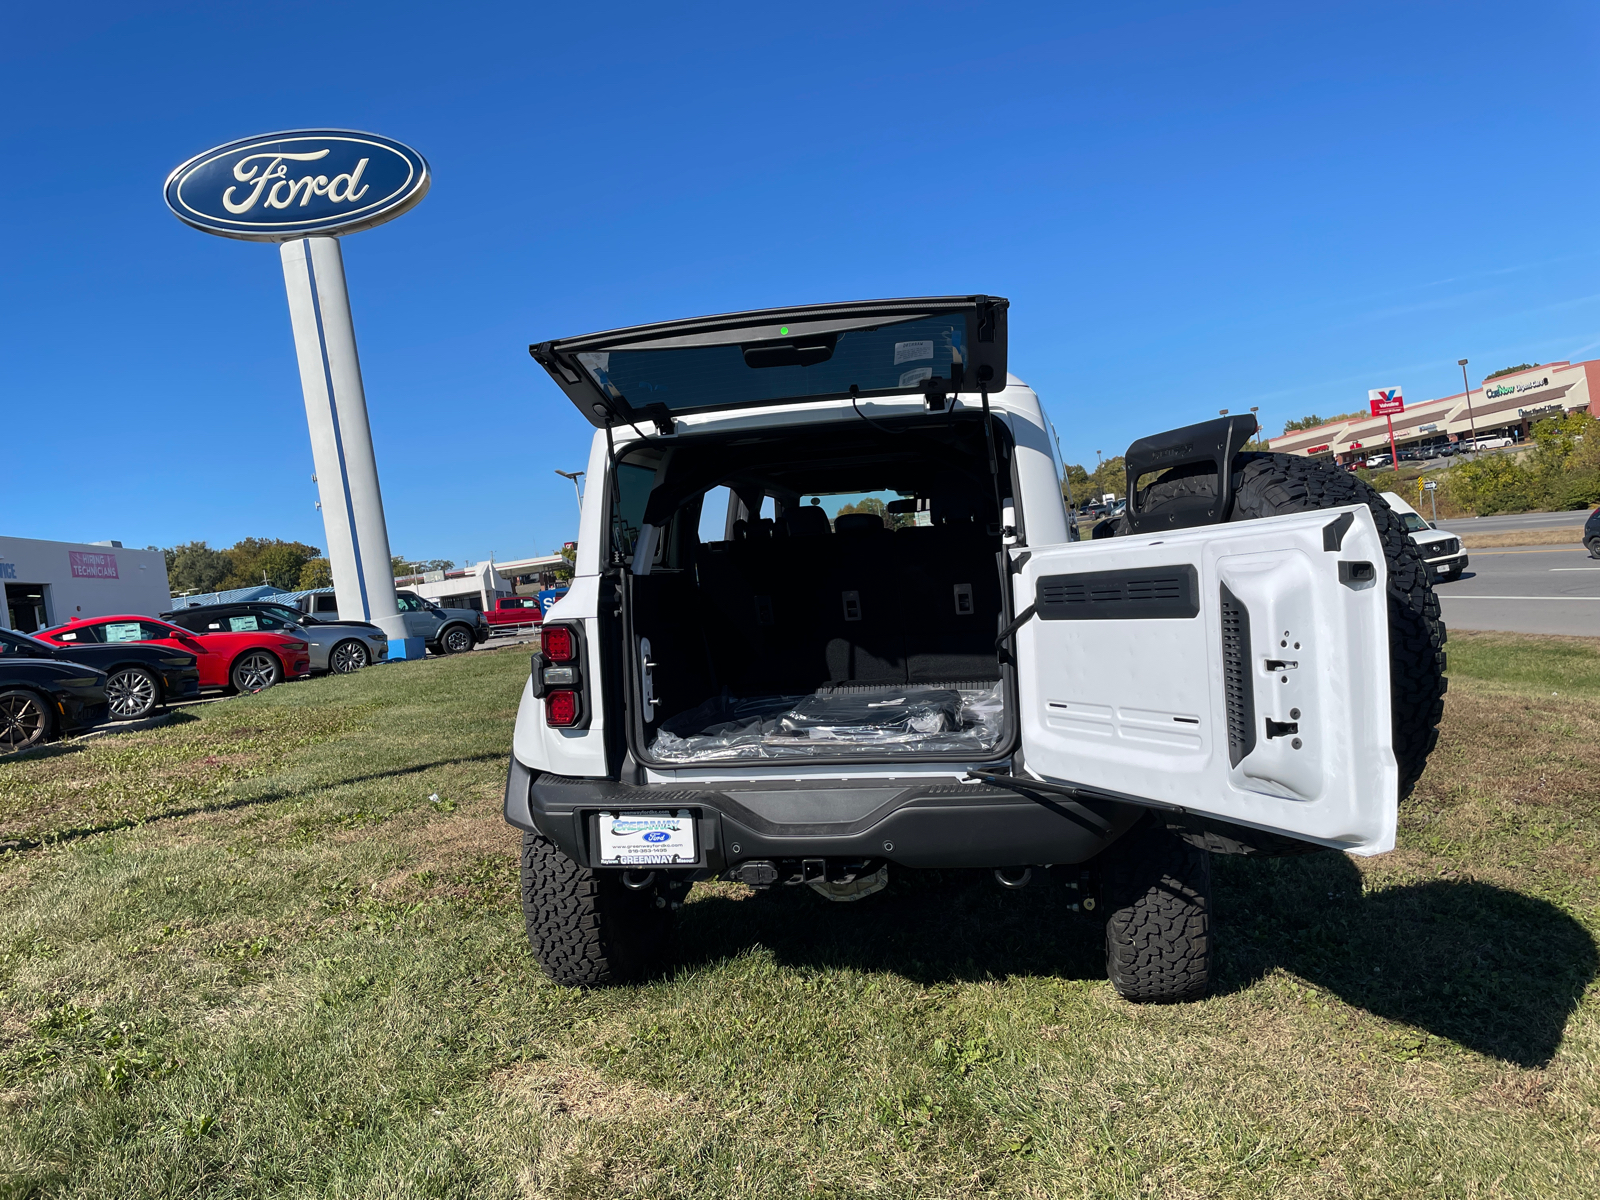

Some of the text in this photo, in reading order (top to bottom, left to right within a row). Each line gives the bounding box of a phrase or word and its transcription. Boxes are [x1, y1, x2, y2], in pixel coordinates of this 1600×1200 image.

[222, 148, 370, 214] Ford
[82, 554, 105, 565] HIRING
[73, 565, 116, 577] TECHNICIANS
[648, 833, 665, 841] Ford
[620, 855, 673, 864] GREENWAY
